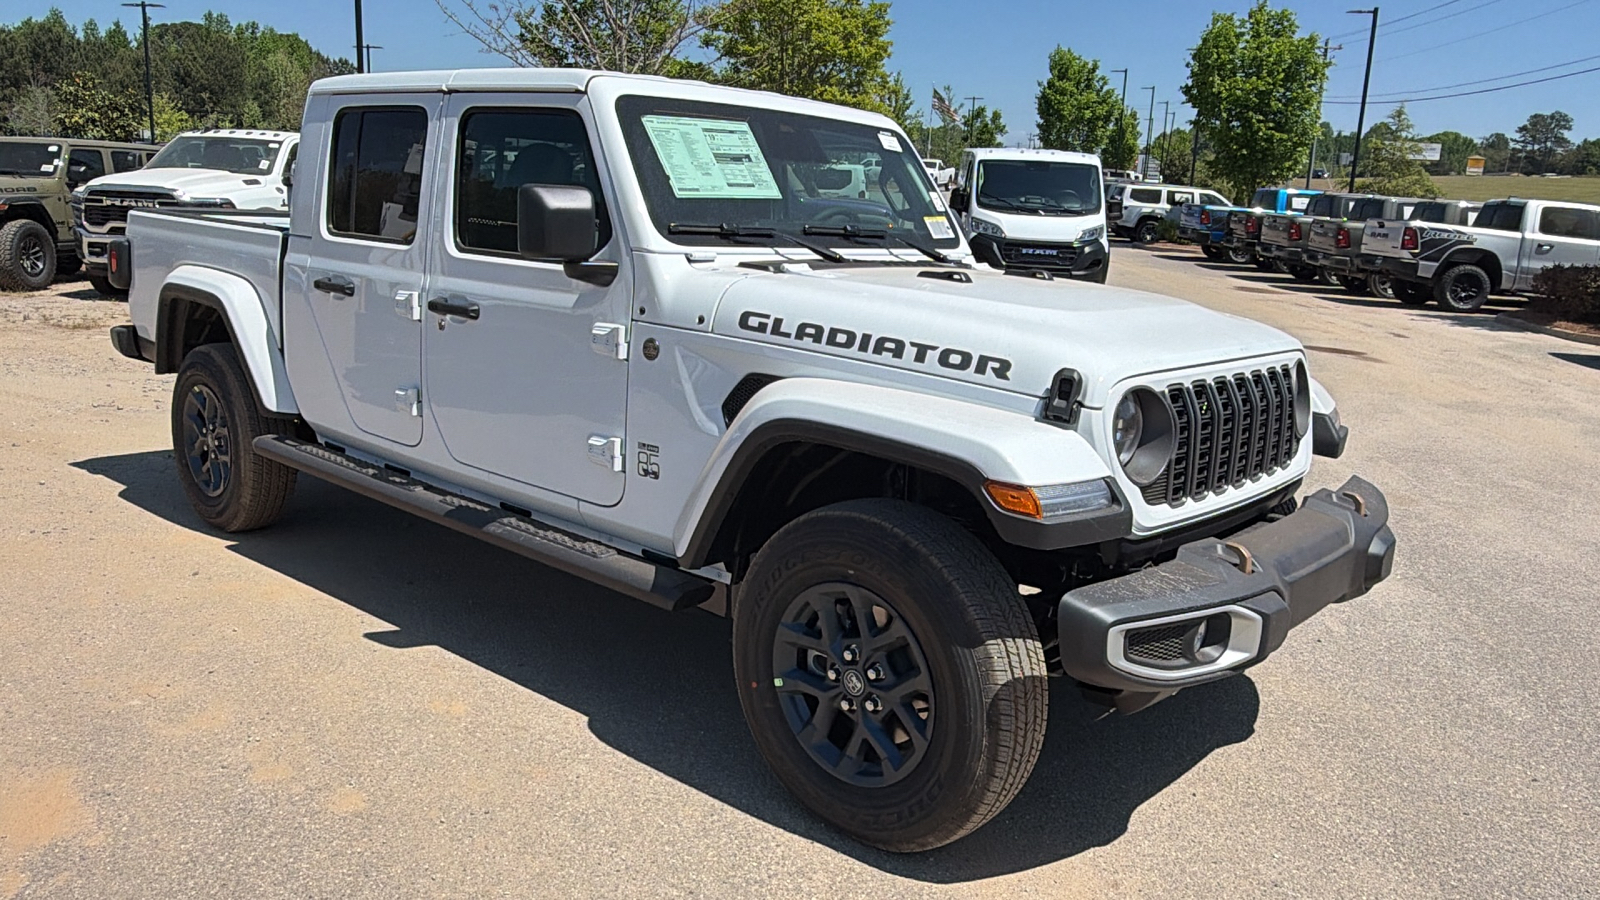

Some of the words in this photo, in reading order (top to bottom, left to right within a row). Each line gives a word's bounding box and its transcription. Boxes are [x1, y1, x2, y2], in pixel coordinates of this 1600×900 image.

[1370, 231, 1389, 239] RAM
[738, 310, 1012, 381] GLADIATOR
[637, 451, 660, 480] 85
[750, 546, 905, 616] RIDGESTON
